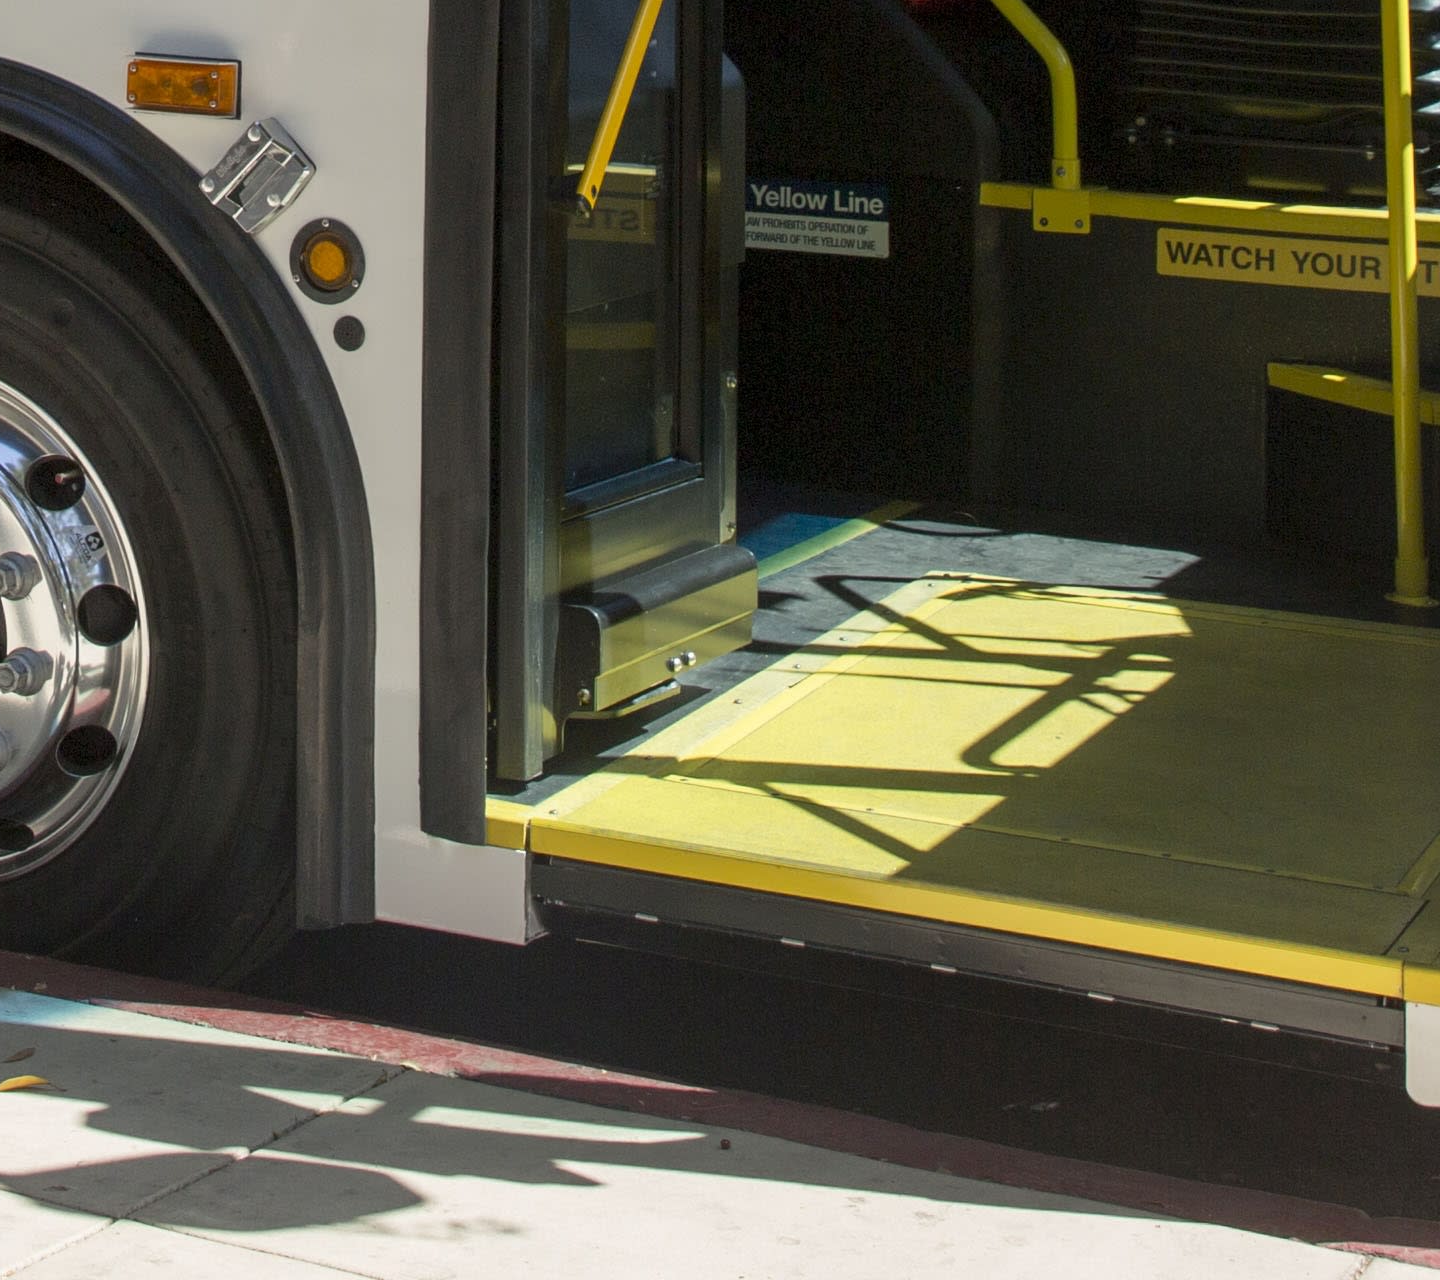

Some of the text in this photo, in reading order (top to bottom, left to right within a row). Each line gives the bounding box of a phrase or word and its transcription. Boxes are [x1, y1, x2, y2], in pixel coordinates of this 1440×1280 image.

[750, 183, 884, 215] Yellow Line
[762, 218, 807, 231] PROHIBITS
[807, 221, 856, 234] OPERATION
[856, 224, 870, 235] OF
[746, 231, 876, 251] FORWARD OF THE YELLOW LINE
[1165, 241, 1275, 272] WATCH
[1291, 250, 1381, 280] YOUR
